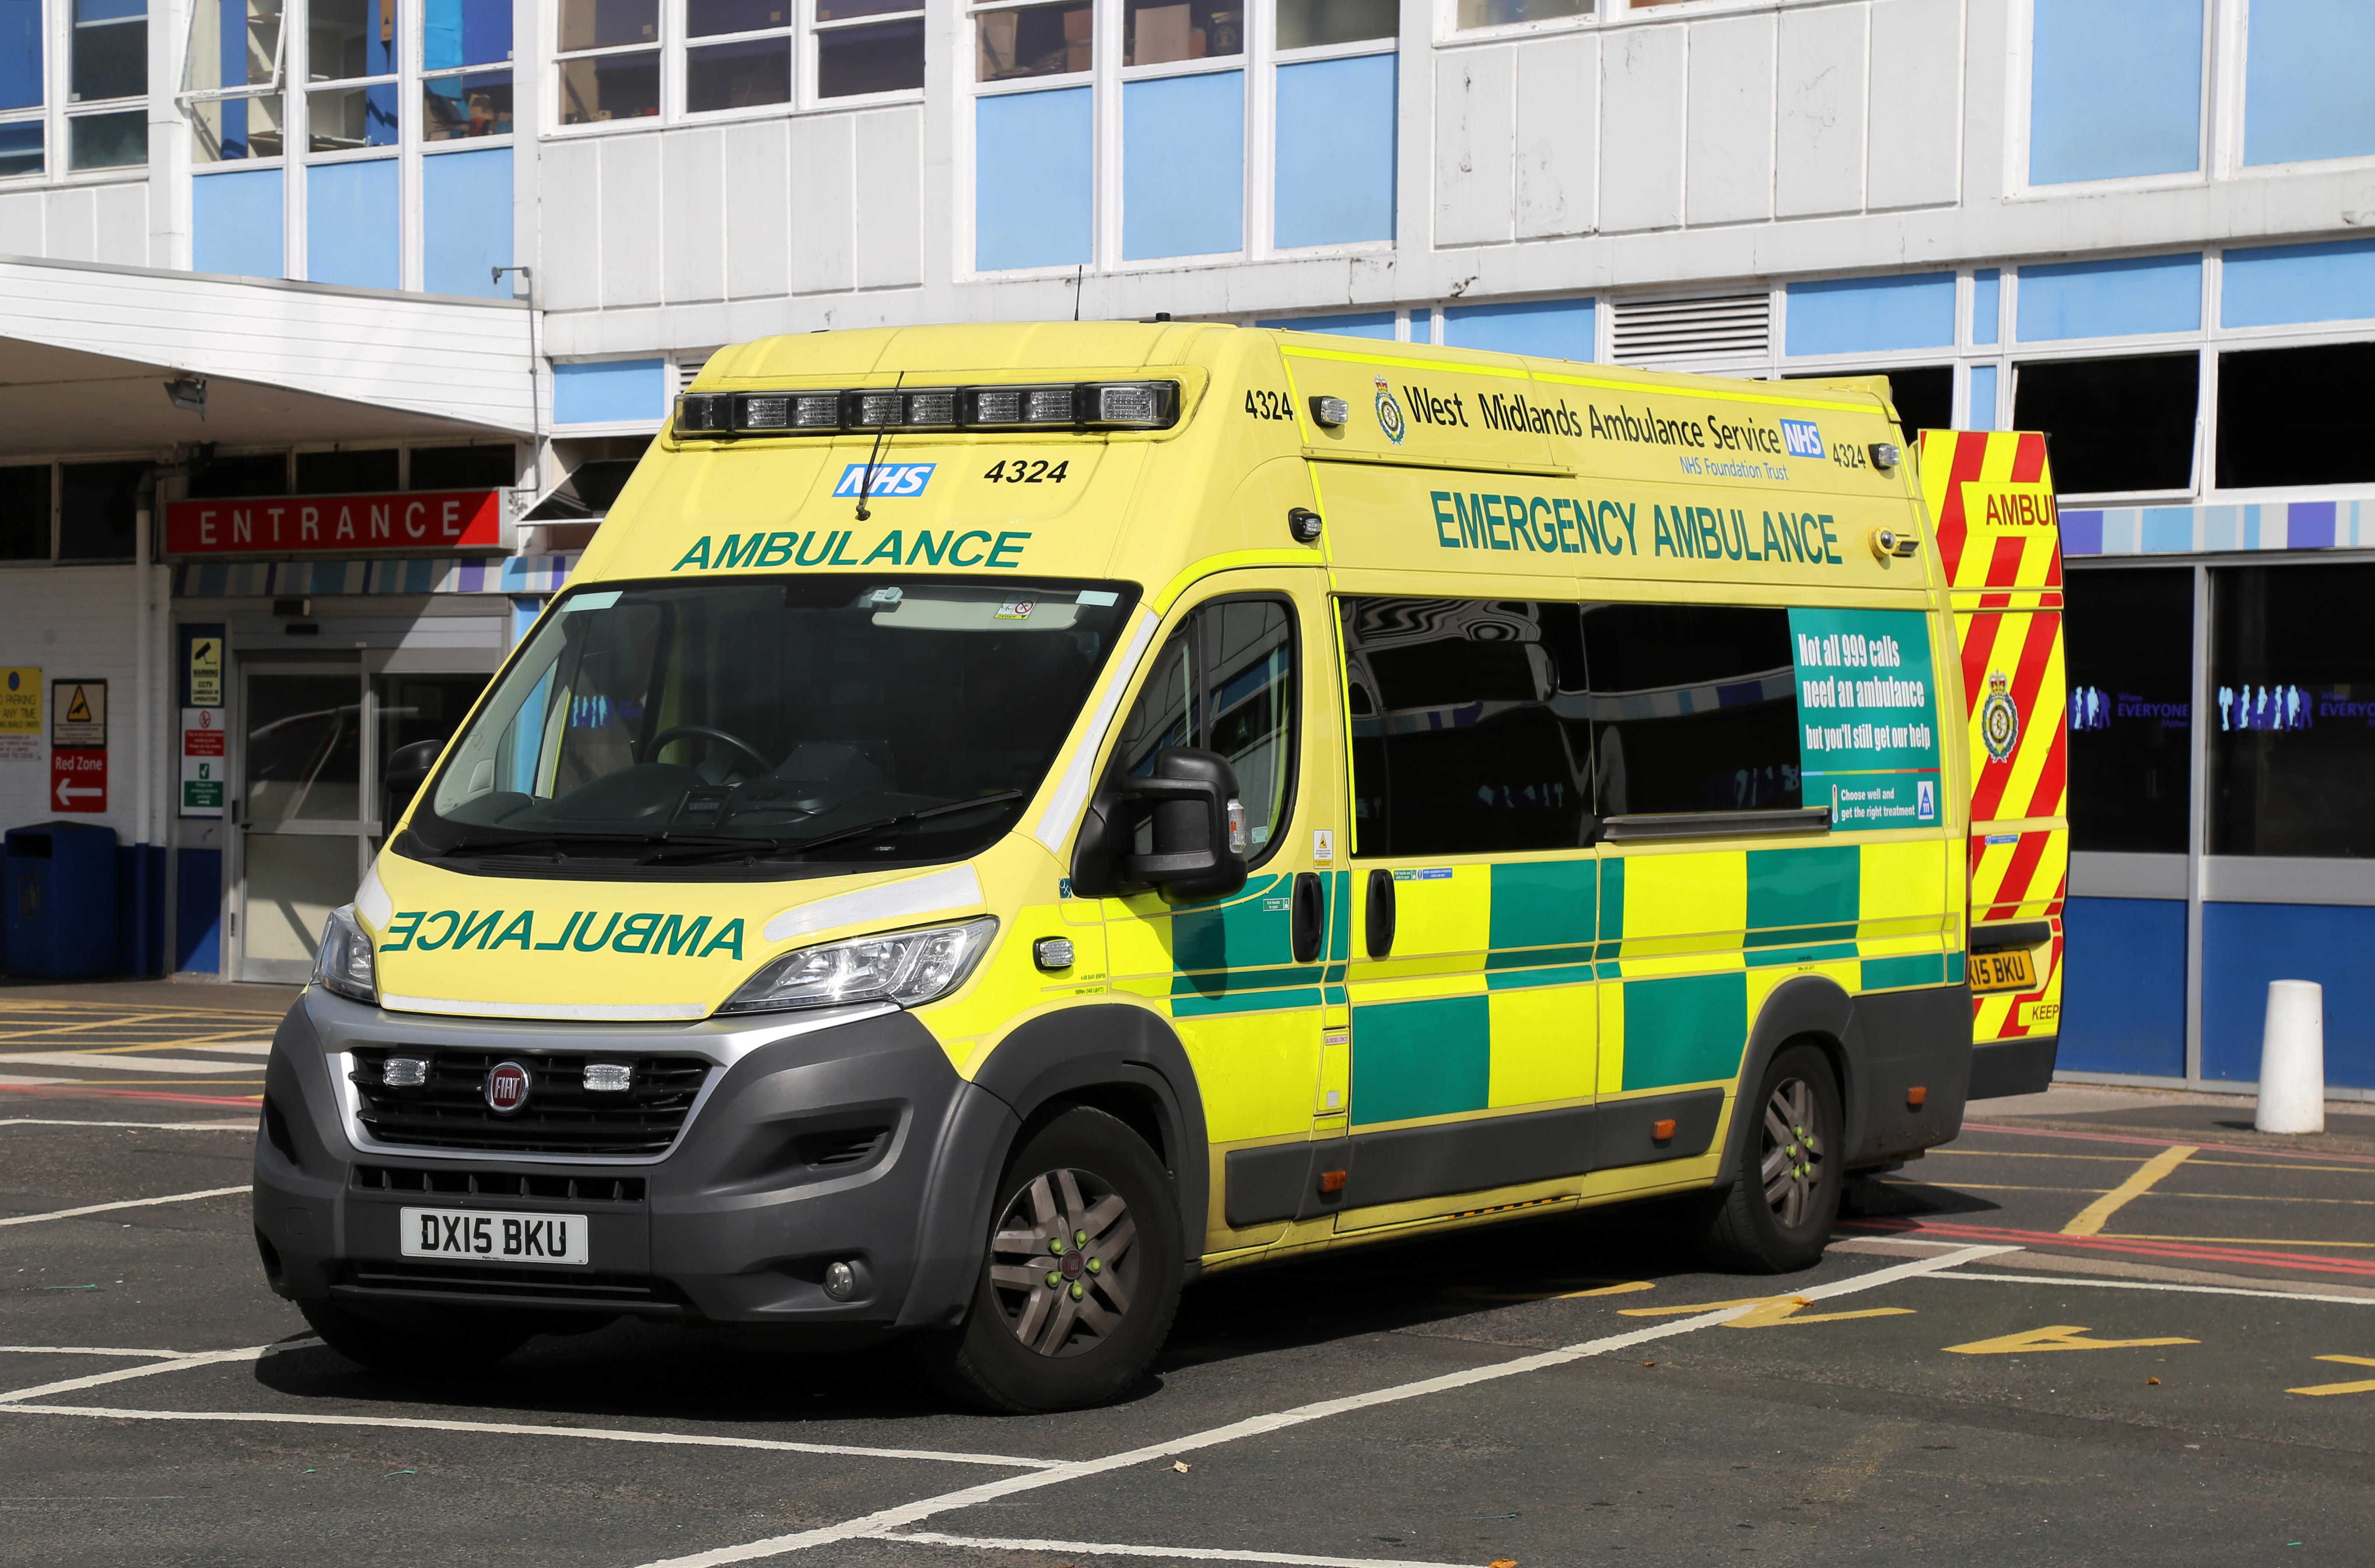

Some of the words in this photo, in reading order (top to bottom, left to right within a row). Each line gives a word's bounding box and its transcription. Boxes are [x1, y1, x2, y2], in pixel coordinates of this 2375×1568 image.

[1245, 390, 1293, 421] 4324
[1403, 385, 1469, 428] West
[1478, 392, 1582, 438] Midlands
[1589, 404, 1704, 448] Ambulance
[1707, 415, 1781, 455] Service
[1782, 422, 1823, 456] NHS
[1680, 456, 1702, 475] NHS
[1704, 458, 1763, 479] Foundation
[1763, 461, 1789, 482] Trust
[1833, 442, 1866, 469] 4324
[836, 464, 933, 495] NHS
[984, 460, 1069, 484] 4324
[200, 501, 460, 544] ENTRANCE
[1430, 490, 1638, 556] EMERGENCY
[1654, 503, 1843, 565] AMBULANCE
[671, 530, 1033, 572] AMBULANCE
[1798, 633, 1823, 666] Not
[1823, 634, 1841, 667] all
[1842, 634, 1868, 667] 999
[1869, 635, 1901, 667] calls
[5, 694, 36, 705] PARKING
[1802, 675, 1837, 708] need
[1837, 680, 1855, 708] an
[1856, 675, 1925, 708] ambulance
[2119, 692, 2143, 701] Where
[3, 708, 18, 718] ANY
[21, 708, 36, 718] TIME
[2118, 703, 2189, 717] EVERYONE
[1806, 724, 1823, 750] but
[1824, 724, 1852, 752] you'll
[1853, 723, 1873, 749] still
[1874, 724, 1890, 752] get
[1892, 727, 1908, 748] our
[1909, 723, 1931, 750] help
[56, 755, 74, 770] Red
[77, 756, 103, 770] Zone
[1841, 789, 1866, 802] Choose
[1868, 788, 1881, 800] well
[1882, 788, 1895, 800] and
[1841, 808, 1853, 822] get
[1854, 806, 1866, 818] the
[1866, 806, 1883, 820] right
[1883, 805, 1915, 817] treatment
[1992, 956, 2025, 983] BKU
[2032, 1004, 2059, 1021] KEEP
[494, 1076, 520, 1100] FIAT
[421, 1214, 492, 1254] DX15
[502, 1220, 566, 1257] BKU
